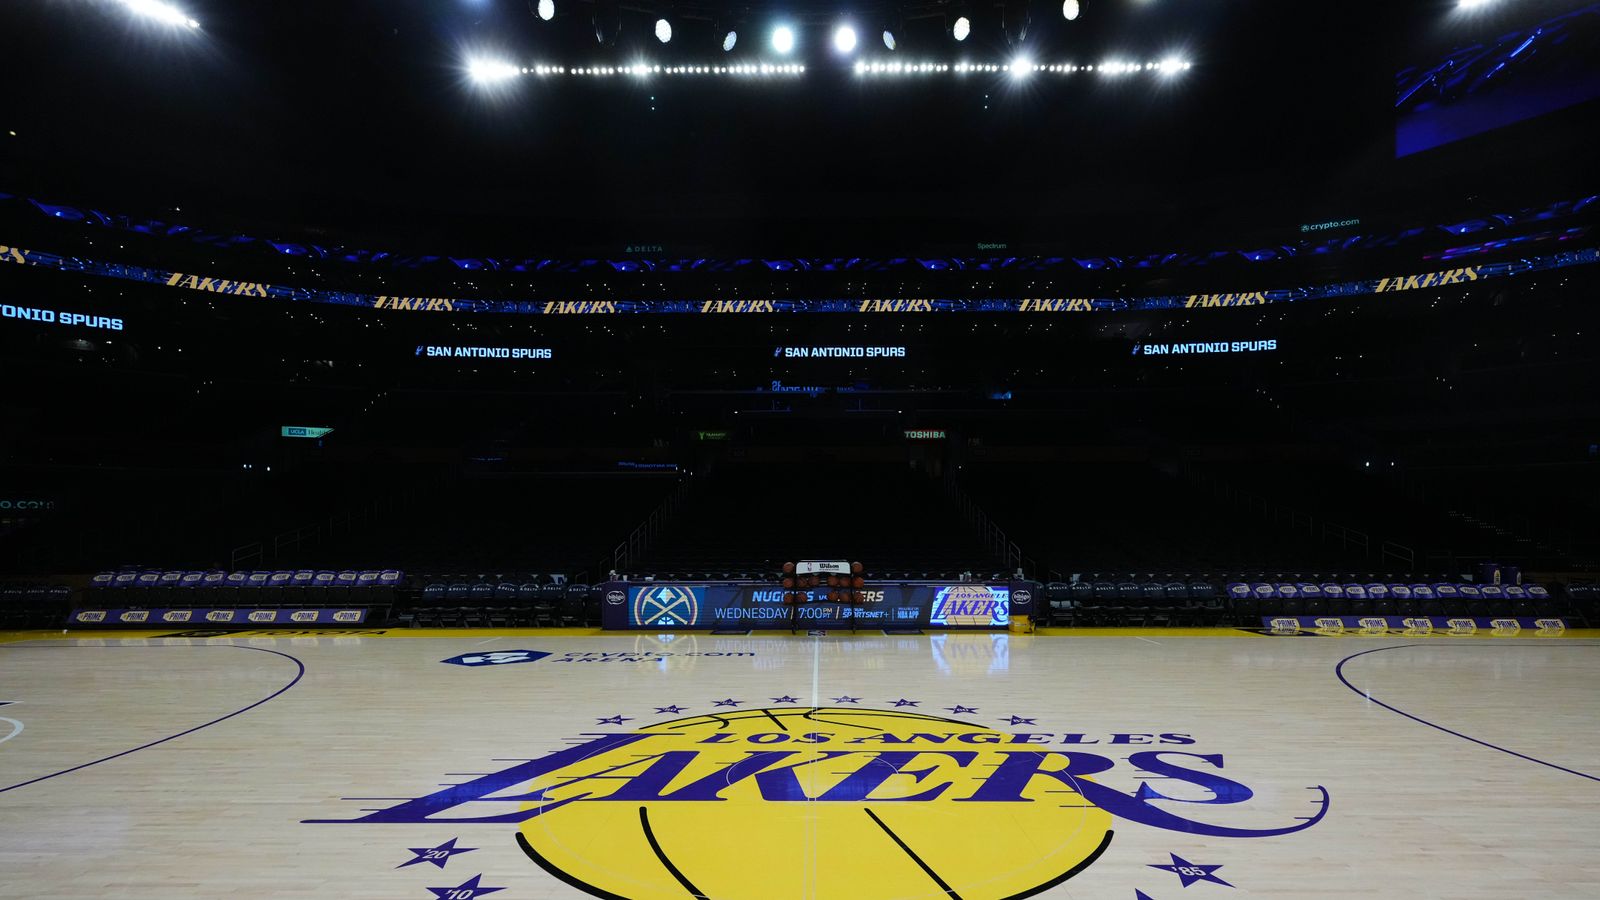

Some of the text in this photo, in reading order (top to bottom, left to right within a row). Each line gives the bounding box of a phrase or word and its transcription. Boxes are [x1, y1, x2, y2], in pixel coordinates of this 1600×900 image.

[1310, 218, 1360, 232] crypto.com
[0, 304, 123, 330] ONIO SPURS
[427, 346, 552, 358] SAN ANTONIO SPURS
[785, 347, 906, 357] SAN ANTONIO SPURS
[1144, 340, 1277, 355] SAN ANTONIO SPURS
[904, 430, 946, 439] TOSHIBA
[752, 591, 814, 602] NUGS
[714, 607, 789, 619] WEDNESDAY
[798, 607, 822, 619] 7:00
[932, 593, 1008, 622] LAKERS
[84, 612, 102, 621] PRIME
[127, 612, 145, 621] PRIME
[170, 612, 188, 621] PRIME
[212, 612, 231, 621] PRIME
[255, 612, 273, 621] PRIME
[297, 612, 315, 621] PRIME
[339, 612, 358, 621] PRIME
[695, 732, 1197, 745] LOS ANGELES
[300, 733, 1330, 838] LAKERS
[422, 848, 450, 859] '20
[1171, 866, 1207, 876] '85
[445, 889, 474, 900] '10
